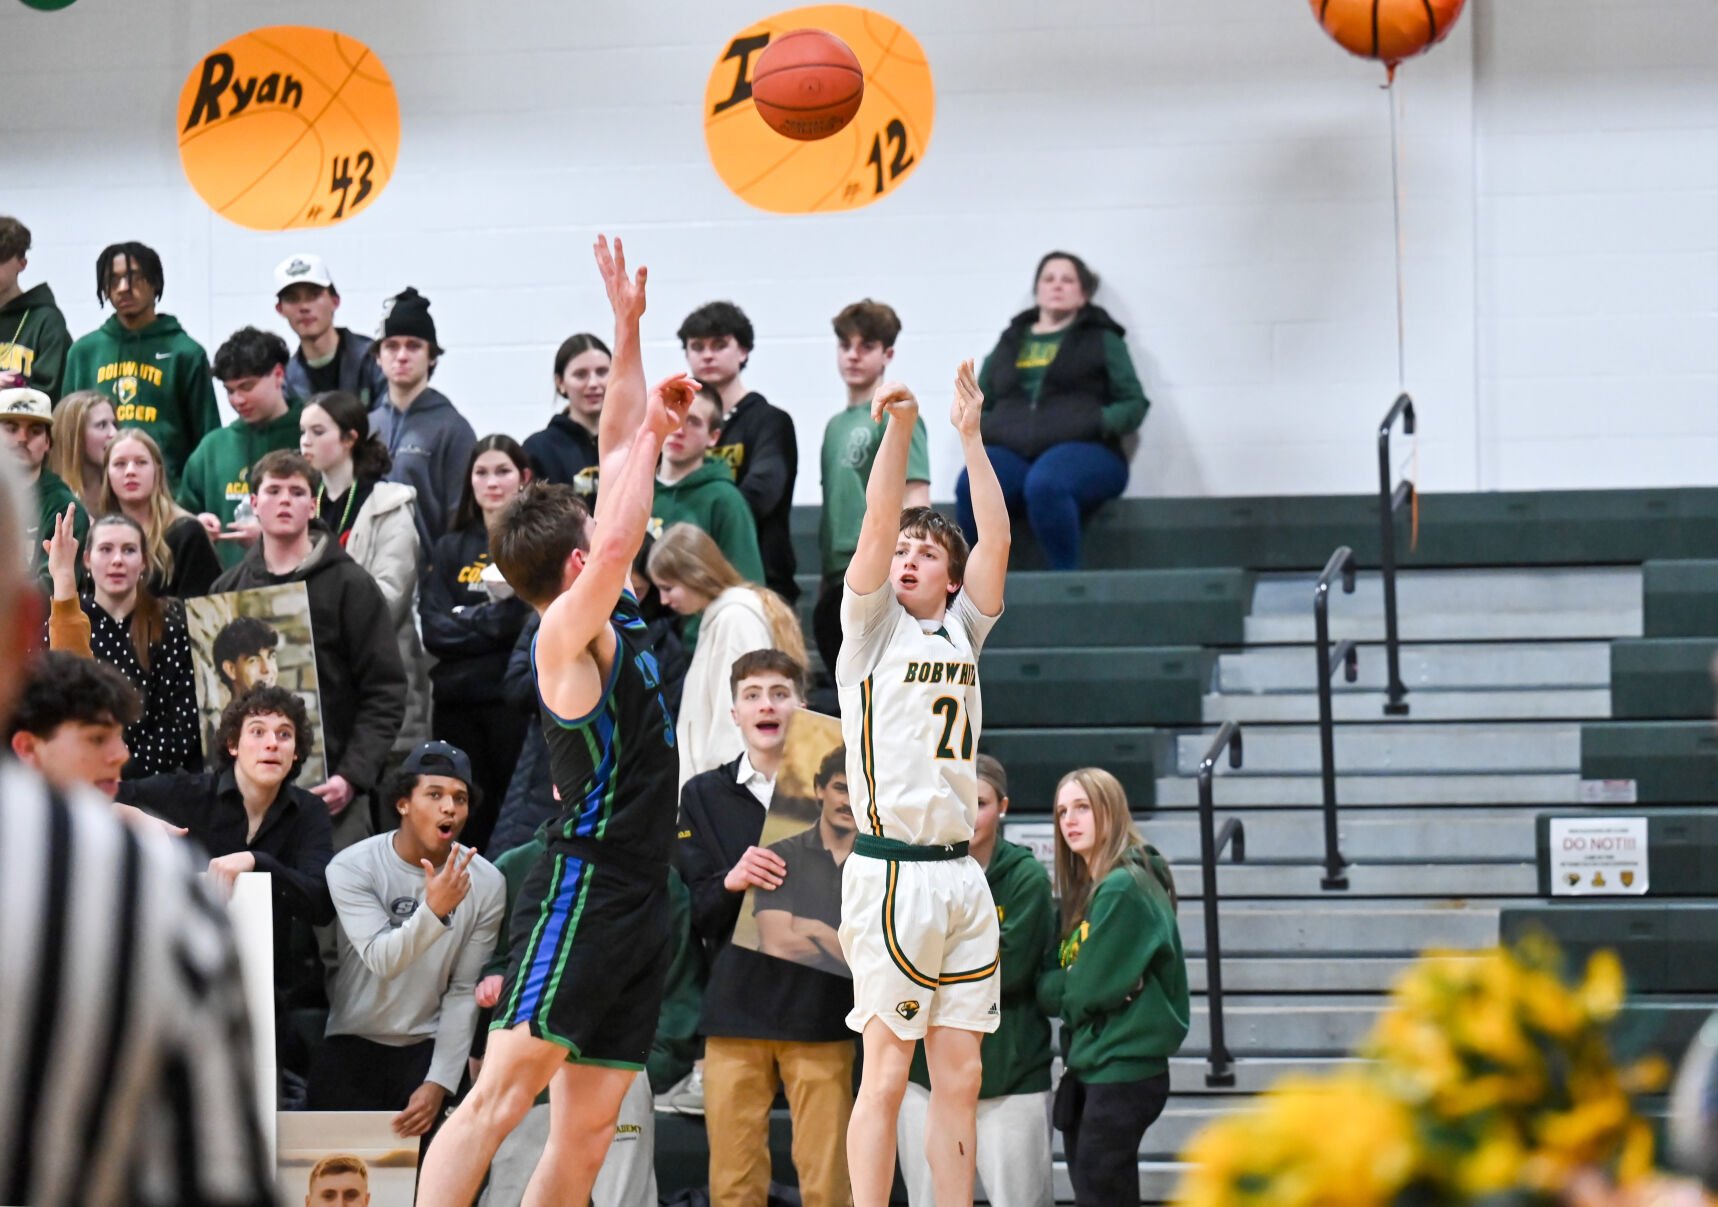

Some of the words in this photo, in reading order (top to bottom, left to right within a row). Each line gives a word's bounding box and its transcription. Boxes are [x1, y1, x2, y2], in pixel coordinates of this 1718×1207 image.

[182, 51, 303, 135] Ryan
[932, 694, 974, 762] 21
[1563, 837, 1586, 851] DO
